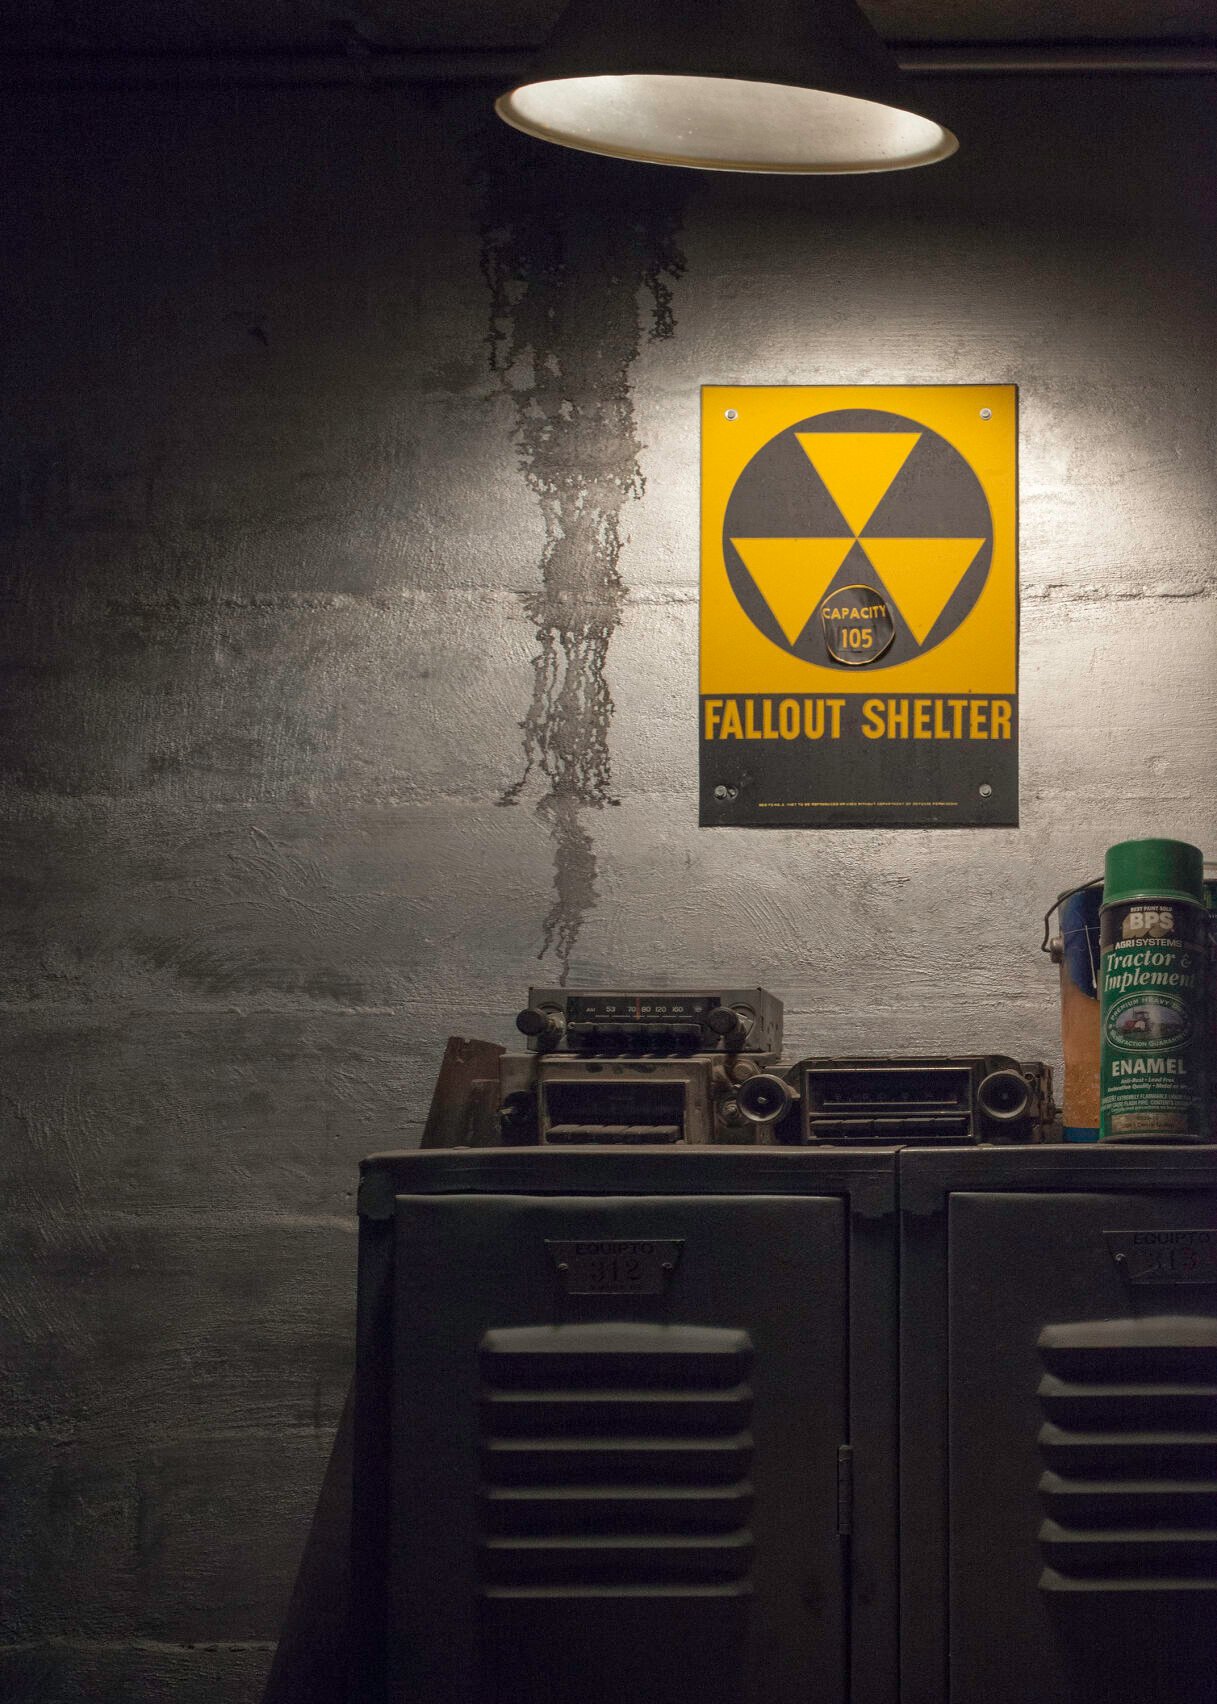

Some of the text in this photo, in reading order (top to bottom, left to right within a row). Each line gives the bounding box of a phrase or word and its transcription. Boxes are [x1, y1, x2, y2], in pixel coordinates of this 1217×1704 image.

[822, 604, 887, 621] CAPACITY
[842, 628, 873, 649] 105
[704, 698, 1012, 740] FALLOUT SHELTER
[1129, 912, 1175, 930] BPS
[1107, 950, 1192, 972] Tractor &
[1112, 1058, 1187, 1077] ENAMEL
